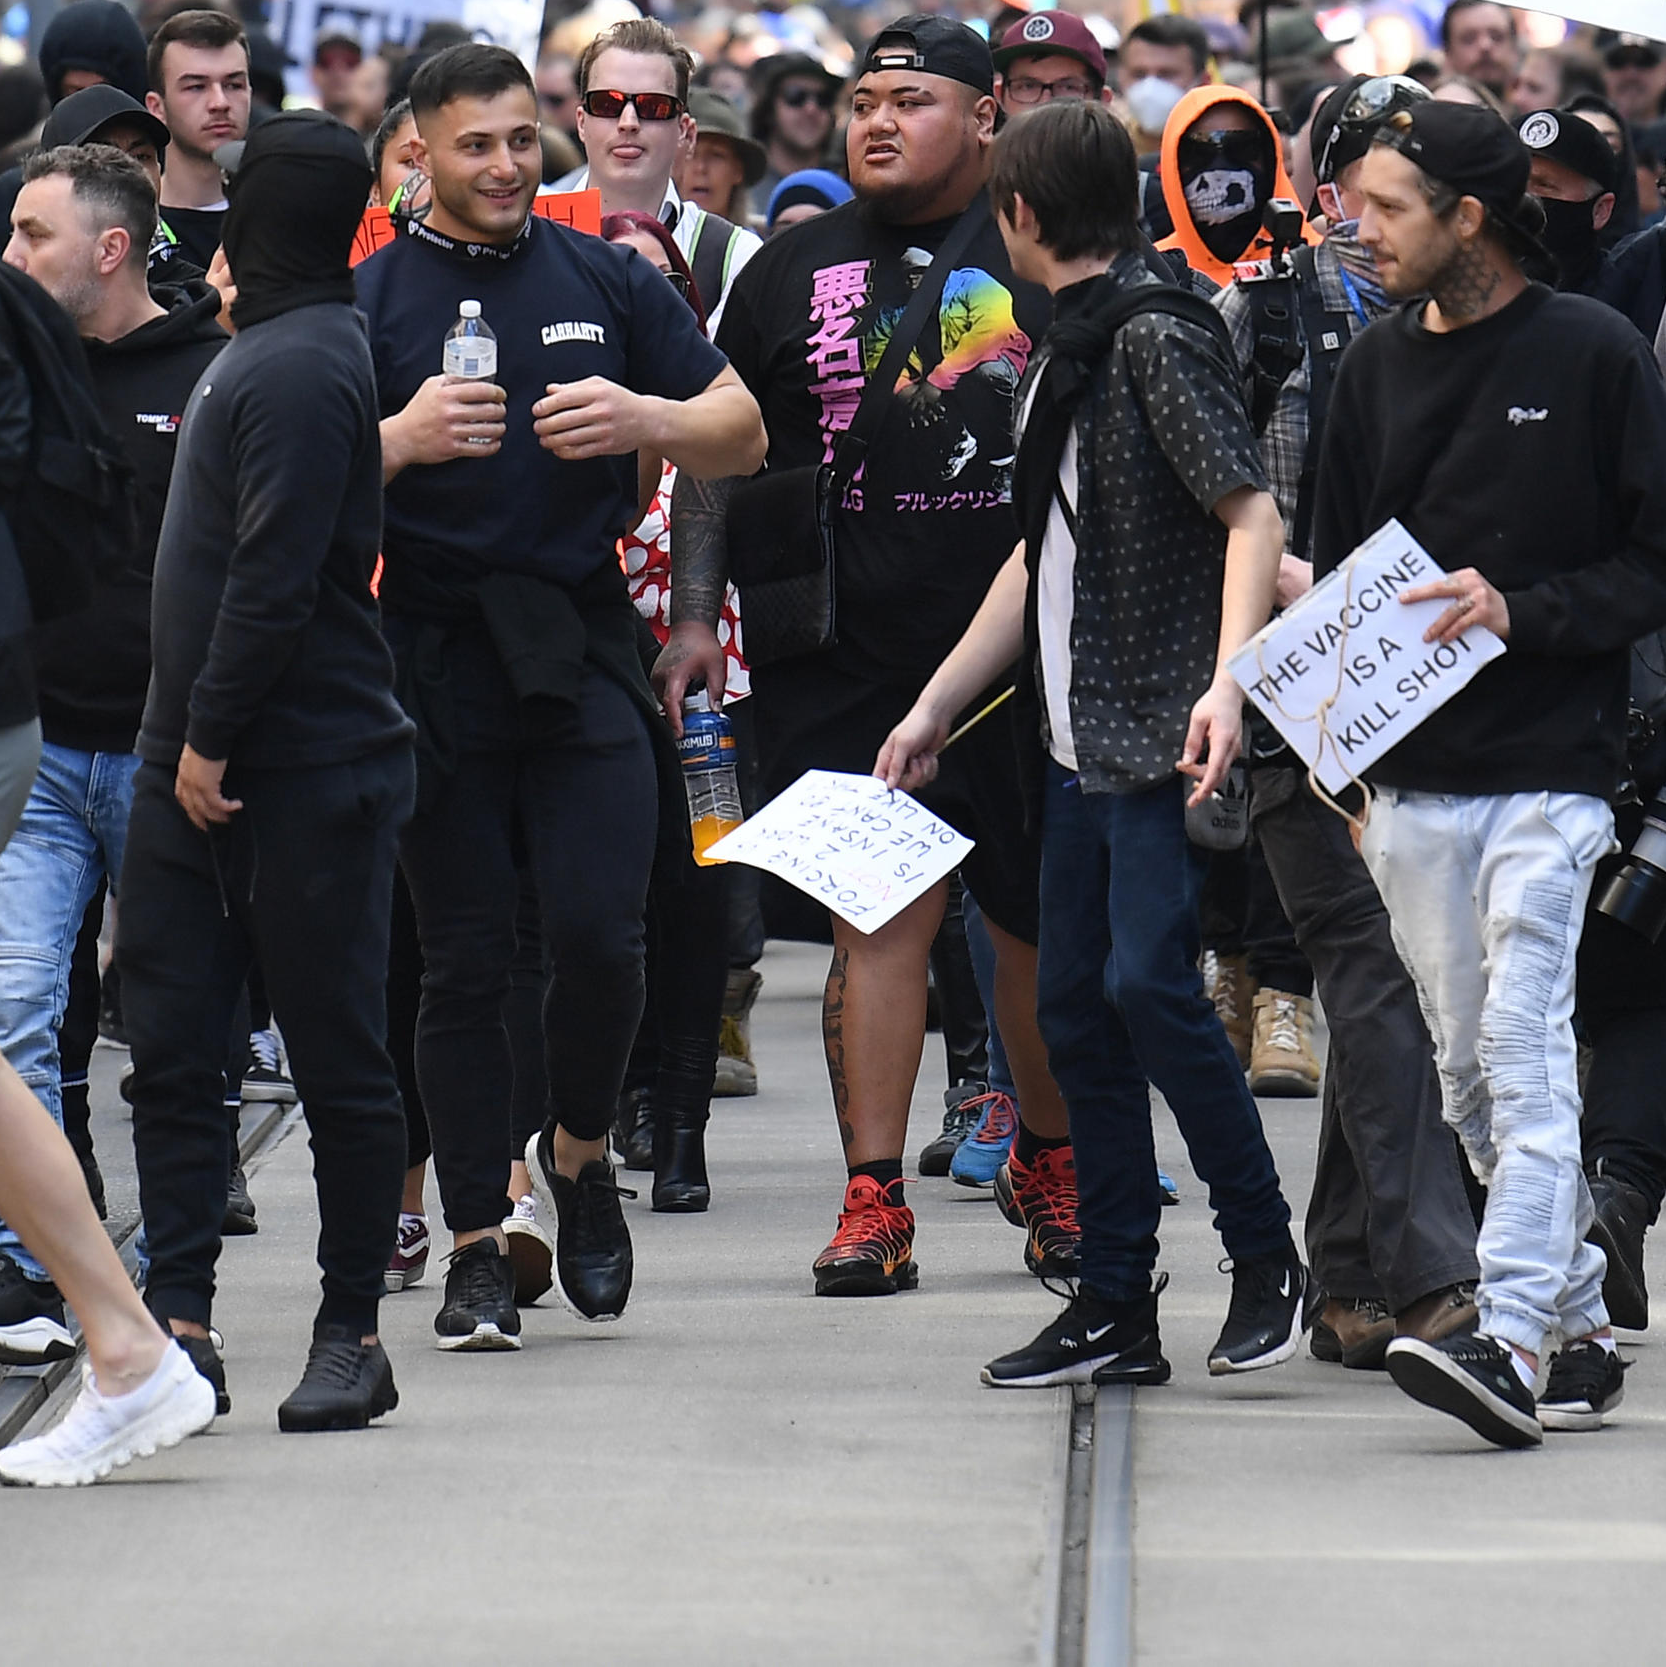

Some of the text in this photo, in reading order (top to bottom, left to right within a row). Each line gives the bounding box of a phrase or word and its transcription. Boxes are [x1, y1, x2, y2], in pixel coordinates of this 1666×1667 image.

[417, 226, 455, 251] Protector
[541, 321, 606, 346] CARHARTT
[136, 413, 170, 424] TOMMY
[1249, 550, 1427, 704] THE VACCINE
[1344, 636, 1404, 688] IS A
[1336, 700, 1401, 755] KILL
[888, 830, 933, 859] WE
[920, 821, 957, 845] ON
[893, 862, 926, 883] IS
